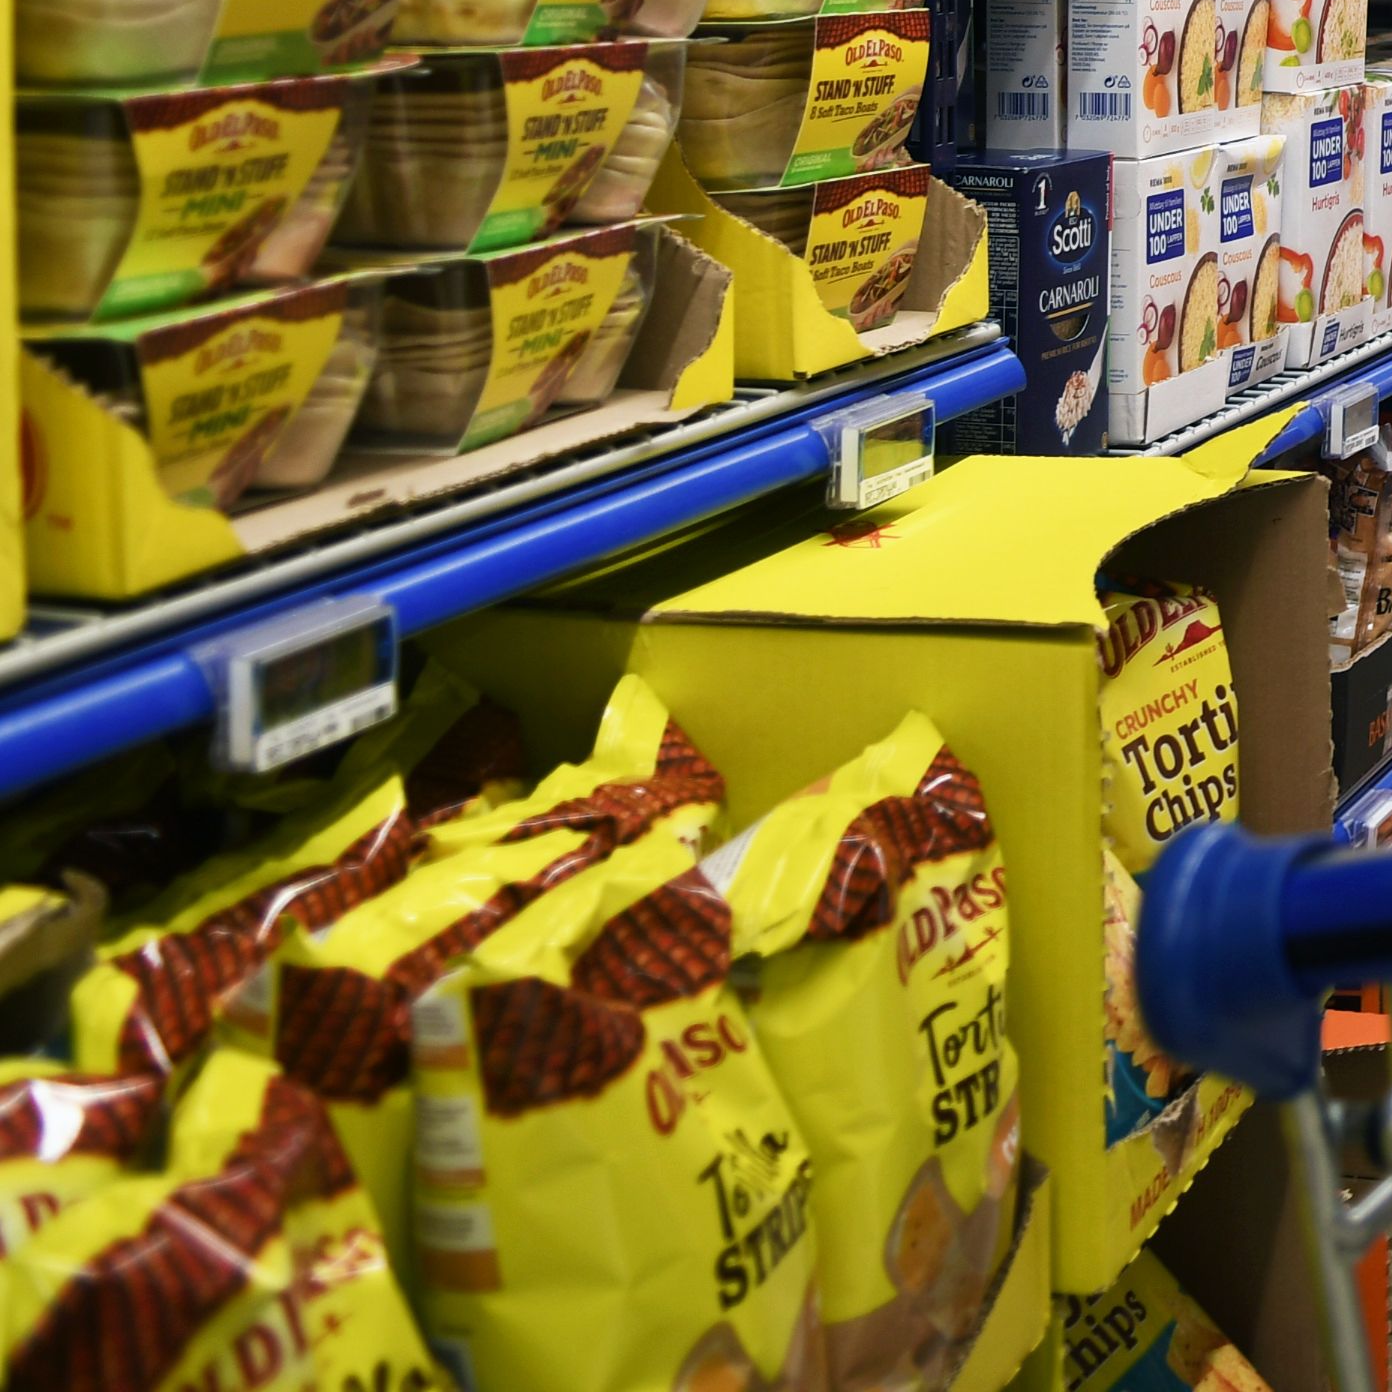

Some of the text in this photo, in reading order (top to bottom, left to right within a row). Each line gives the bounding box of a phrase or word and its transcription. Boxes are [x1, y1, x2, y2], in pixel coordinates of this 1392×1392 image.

[1219, 0, 1245, 12] Couscous
[814, 77, 850, 100] STAND
[864, 74, 895, 96] STUFF
[809, 101, 879, 119] 8 Soft Taco Boats
[533, 139, 578, 163] MINI
[1312, 138, 1342, 161] UNDER
[1312, 161, 1328, 184] 100
[1037, 178, 1047, 210] 1
[1222, 191, 1250, 215] UNDER
[1311, 192, 1341, 213] Hurtigris
[1149, 209, 1183, 233] UNDER
[1222, 215, 1238, 235] 100
[810, 238, 847, 265] STAND
[859, 231, 891, 258] STUFF
[1052, 216, 1092, 256] Scotti
[1149, 235, 1167, 257] 100
[814, 259, 875, 281] Soft Taco Boats
[1222, 250, 1253, 267] Couscous
[1149, 270, 1183, 289] Couscous
[1038, 275, 1099, 313] CARNAROLI
[1114, 678, 1199, 741] CRUNCHY
[1122, 682, 1239, 799] Torti
[1144, 755, 1238, 845] Chips
